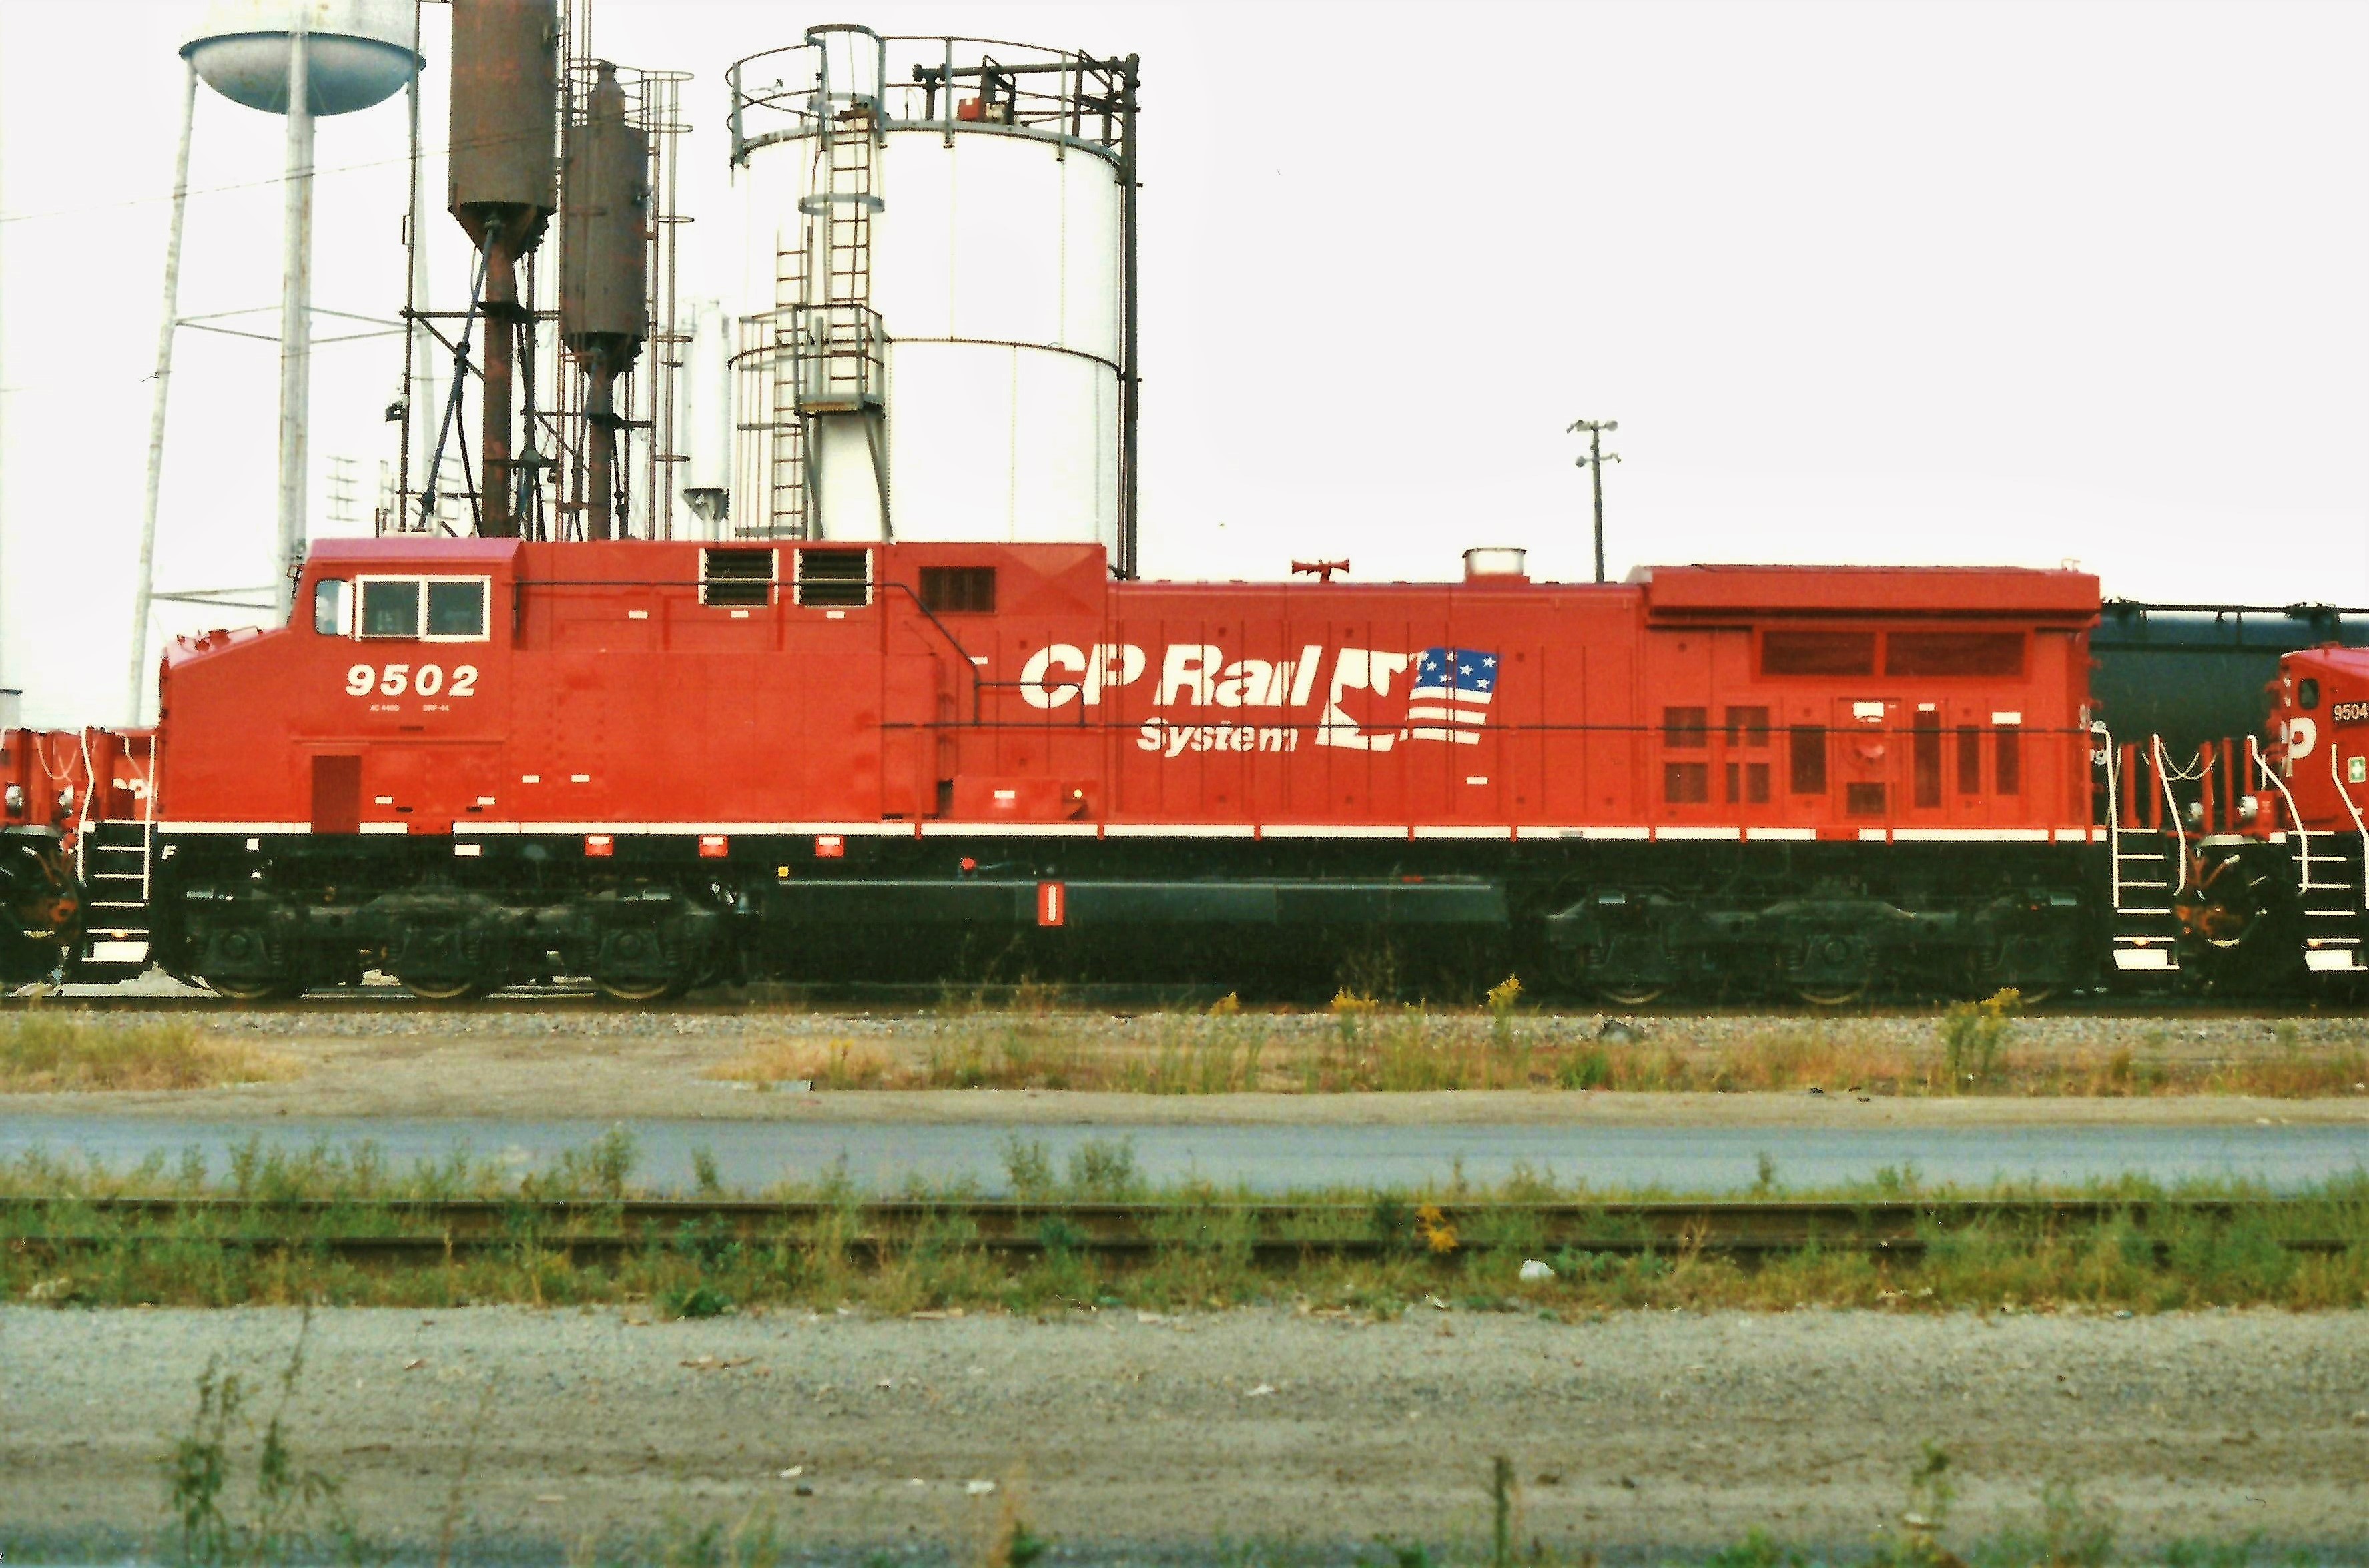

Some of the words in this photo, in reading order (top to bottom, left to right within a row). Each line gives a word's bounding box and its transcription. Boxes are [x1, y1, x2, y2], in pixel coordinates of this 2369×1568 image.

[346, 664, 478, 697] 9502
[1019, 643, 1146, 709] CP
[1153, 644, 1323, 707] Rail
[2334, 703, 2368, 721] 9504
[1137, 717, 1298, 757] System
[161, 845, 177, 861] F
